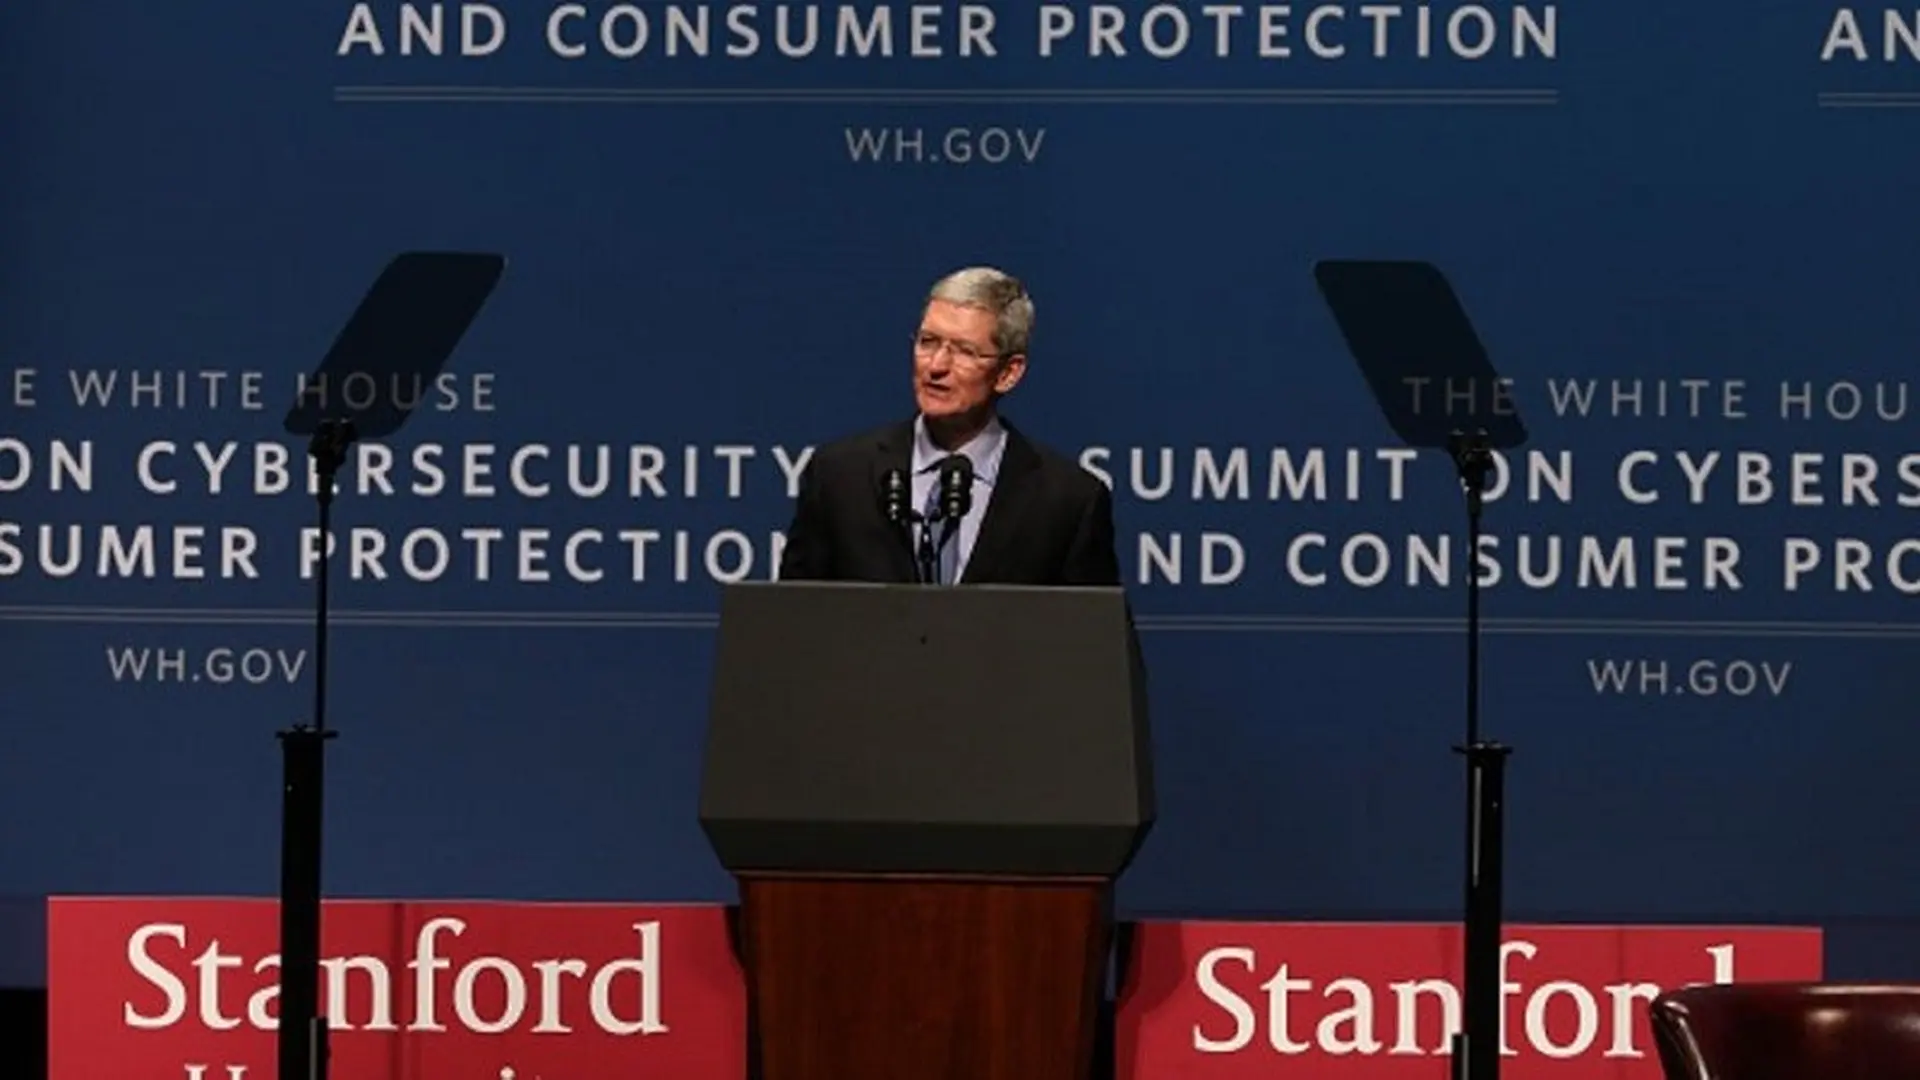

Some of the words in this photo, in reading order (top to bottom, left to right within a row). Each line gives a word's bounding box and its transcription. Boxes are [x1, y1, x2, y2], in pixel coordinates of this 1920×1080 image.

[338, 4, 506, 57] AND
[547, 4, 998, 58] CONSUMER
[1039, 5, 1557, 59] PROTECTION
[1821, 8, 1920, 61] AN
[845, 128, 1045, 163] WH.GOV
[69, 369, 265, 410] WHITE
[297, 372, 496, 412] HOUSE
[1402, 376, 1514, 416] THE
[1548, 378, 1747, 418] WHITE
[1781, 382, 1907, 421] HOU
[1079, 447, 1418, 501] SUMMIT
[1618, 450, 1920, 507] CYBERS
[1138, 532, 1246, 587] ND
[1286, 533, 1743, 591] CONSUMER
[107, 647, 307, 684] WH.GOV
[1587, 660, 1791, 696] WH.GOV
[1193, 940, 1735, 1059] Stanfor
